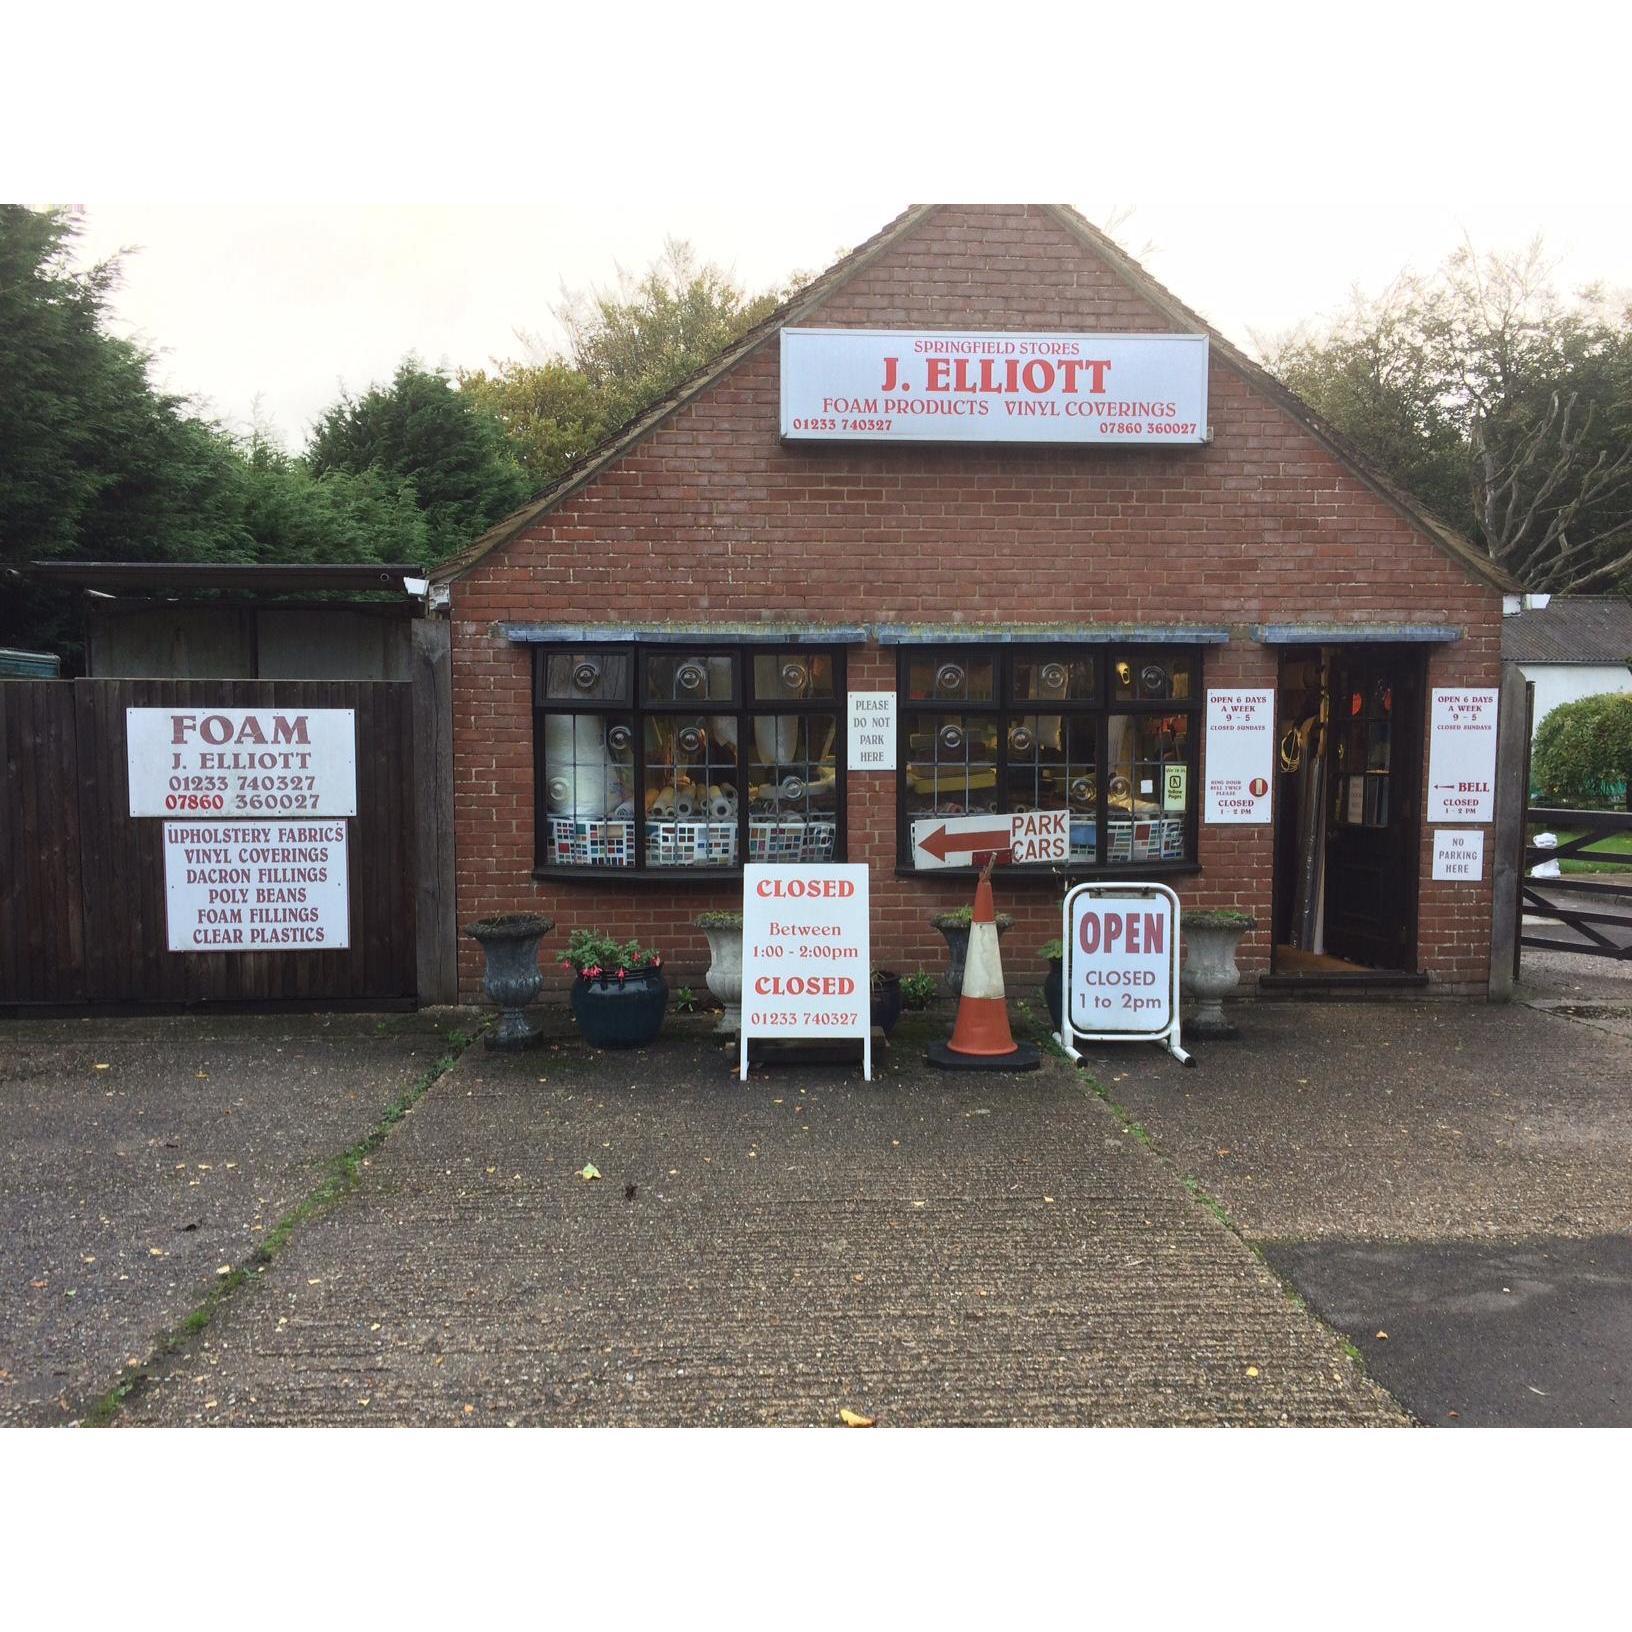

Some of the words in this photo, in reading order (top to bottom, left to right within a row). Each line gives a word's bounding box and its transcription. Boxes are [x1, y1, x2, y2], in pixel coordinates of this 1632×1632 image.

[914, 340, 1016, 354] SPRINGFIELD
[1019, 342, 1080, 355] STORES
[881, 357, 910, 391] J.
[925, 358, 1111, 394] ELLIOTT
[823, 398, 878, 414] FOAM
[885, 399, 989, 416] PRODUCTS
[1004, 401, 1060, 416] VINYL
[1065, 401, 1176, 417] COVERINGS
[793, 419, 836, 430] 01233
[841, 420, 892, 431] 740327
[1100, 422, 1142, 433] 07860
[1147, 422, 1197, 434] 360027
[856, 700, 889, 710] PLEASE
[171, 715, 311, 745] FOAM
[854, 717, 867, 728] DO
[872, 717, 890, 727] NOT
[860, 735, 884, 744] PARK
[172, 753, 187, 770] J.
[199, 752, 311, 769] ELLIOTT
[861, 752, 884, 761] HERE
[169, 776, 228, 791] 01233
[238, 776, 315, 791] 740327
[1458, 783, 1490, 792] BELL
[166, 794, 224, 810] 07860
[235, 794, 320, 810] 360027
[1012, 813, 1066, 837] PARK
[168, 828, 271, 844] UPHOLSTERY
[278, 827, 344, 842] FABRICS
[1452, 838, 1464, 846] NO
[184, 848, 232, 864] VINYL
[239, 847, 329, 863] COVERINGS
[1012, 838, 1065, 862] CARS
[1439, 852, 1477, 860] PARKING
[186, 868, 251, 884] DACRON
[258, 867, 328, 883] FILLINGS
[1446, 865, 1469, 873] HERE
[209, 889, 249, 904] POLY
[256, 888, 307, 903] BEANS
[757, 880, 855, 898] CLOSED
[198, 909, 243, 924] FOAM
[250, 908, 319, 923] FILLINGS
[193, 929, 243, 944] CLEAR
[250, 927, 325, 943] PLASTICS
[769, 922, 841, 936] Between
[1080, 912, 1164, 954] OPEN
[753, 946, 783, 958] 1:00
[799, 945, 858, 960] 2:00pm
[754, 977, 855, 995] CLOSED
[1086, 971, 1156, 986] CLOSED
[1080, 993, 1086, 1008] 1
[1095, 995, 1111, 1008] to
[1122, 993, 1161, 1012] 2pm
[751, 1013, 797, 1025] 01233
[803, 1013, 858, 1025] 740327
